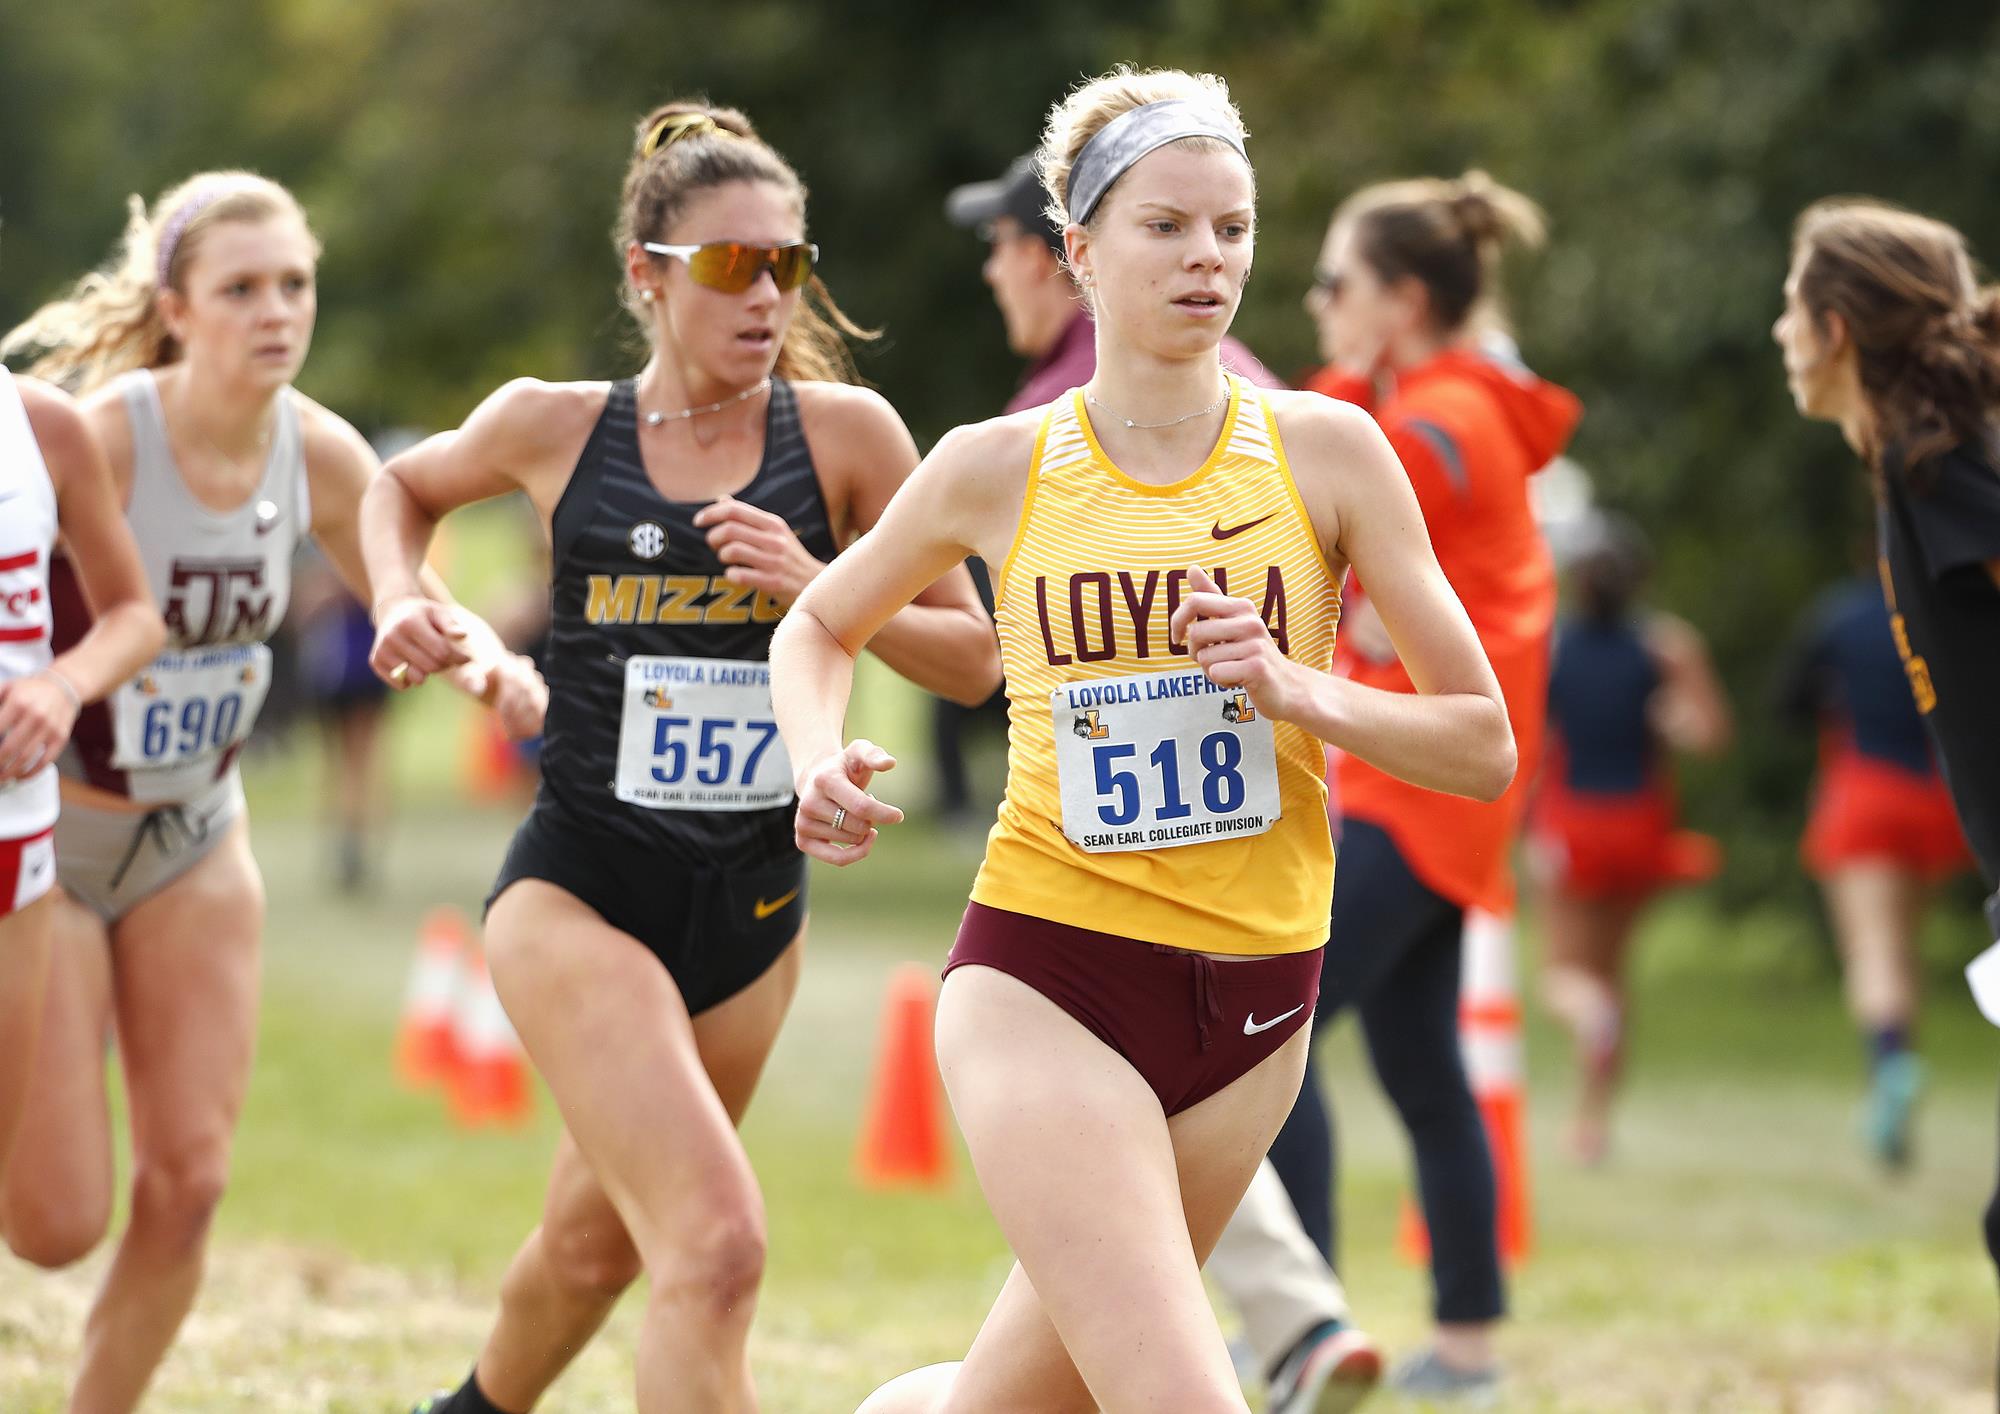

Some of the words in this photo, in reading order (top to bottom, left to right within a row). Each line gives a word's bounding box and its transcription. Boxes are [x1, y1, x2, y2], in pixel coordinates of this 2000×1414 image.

[644, 662, 705, 683] LOYOLA
[1068, 682, 1141, 710] LOYOLA
[143, 690, 242, 758] 690
[651, 717, 779, 787] 557
[1091, 730, 1246, 827] 518
[1083, 833, 1115, 847] SEAN
[1117, 831, 1146, 845] EARL
[1149, 822, 1212, 842] COLLEGIATE
[1215, 816, 1263, 833] DIVISION
